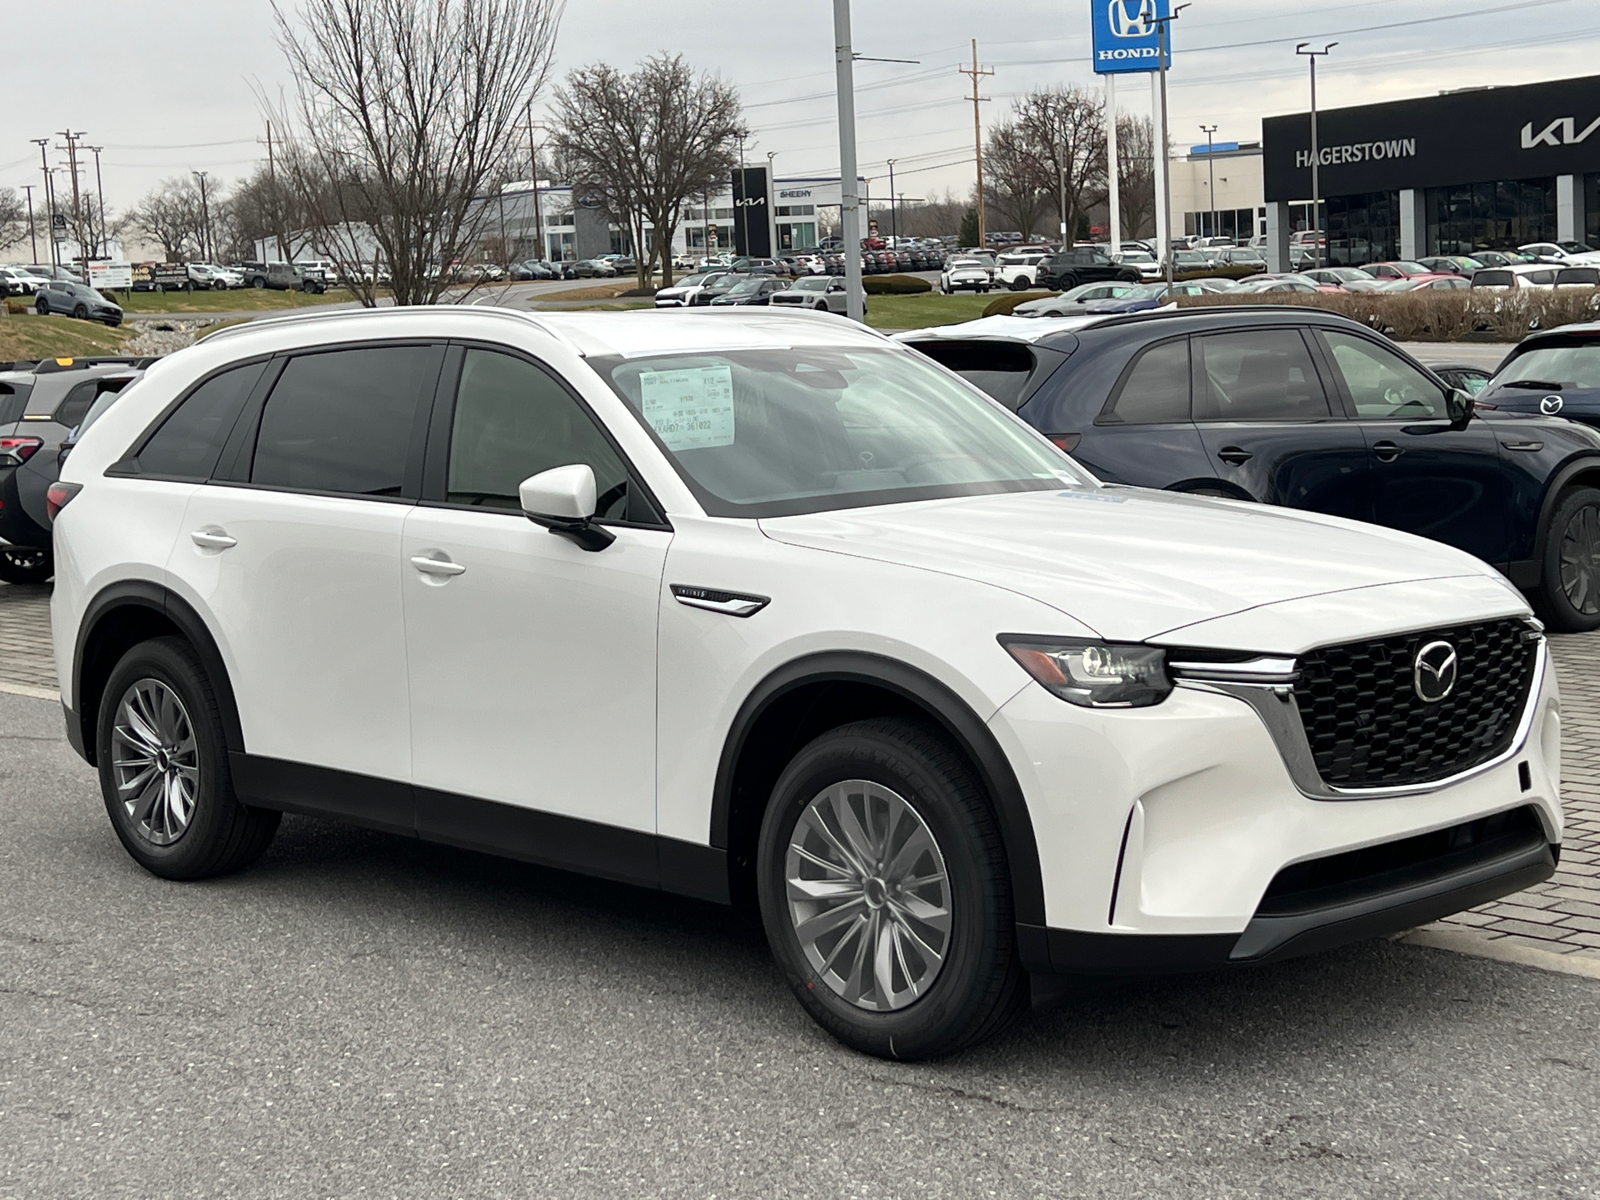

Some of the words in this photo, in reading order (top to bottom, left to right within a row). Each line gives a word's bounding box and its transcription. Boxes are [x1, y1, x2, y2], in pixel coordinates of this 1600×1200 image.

[1098, 47, 1168, 60] HONDA
[1296, 138, 1416, 168] HAGERSTOWN
[780, 190, 812, 198] SHEEHY
